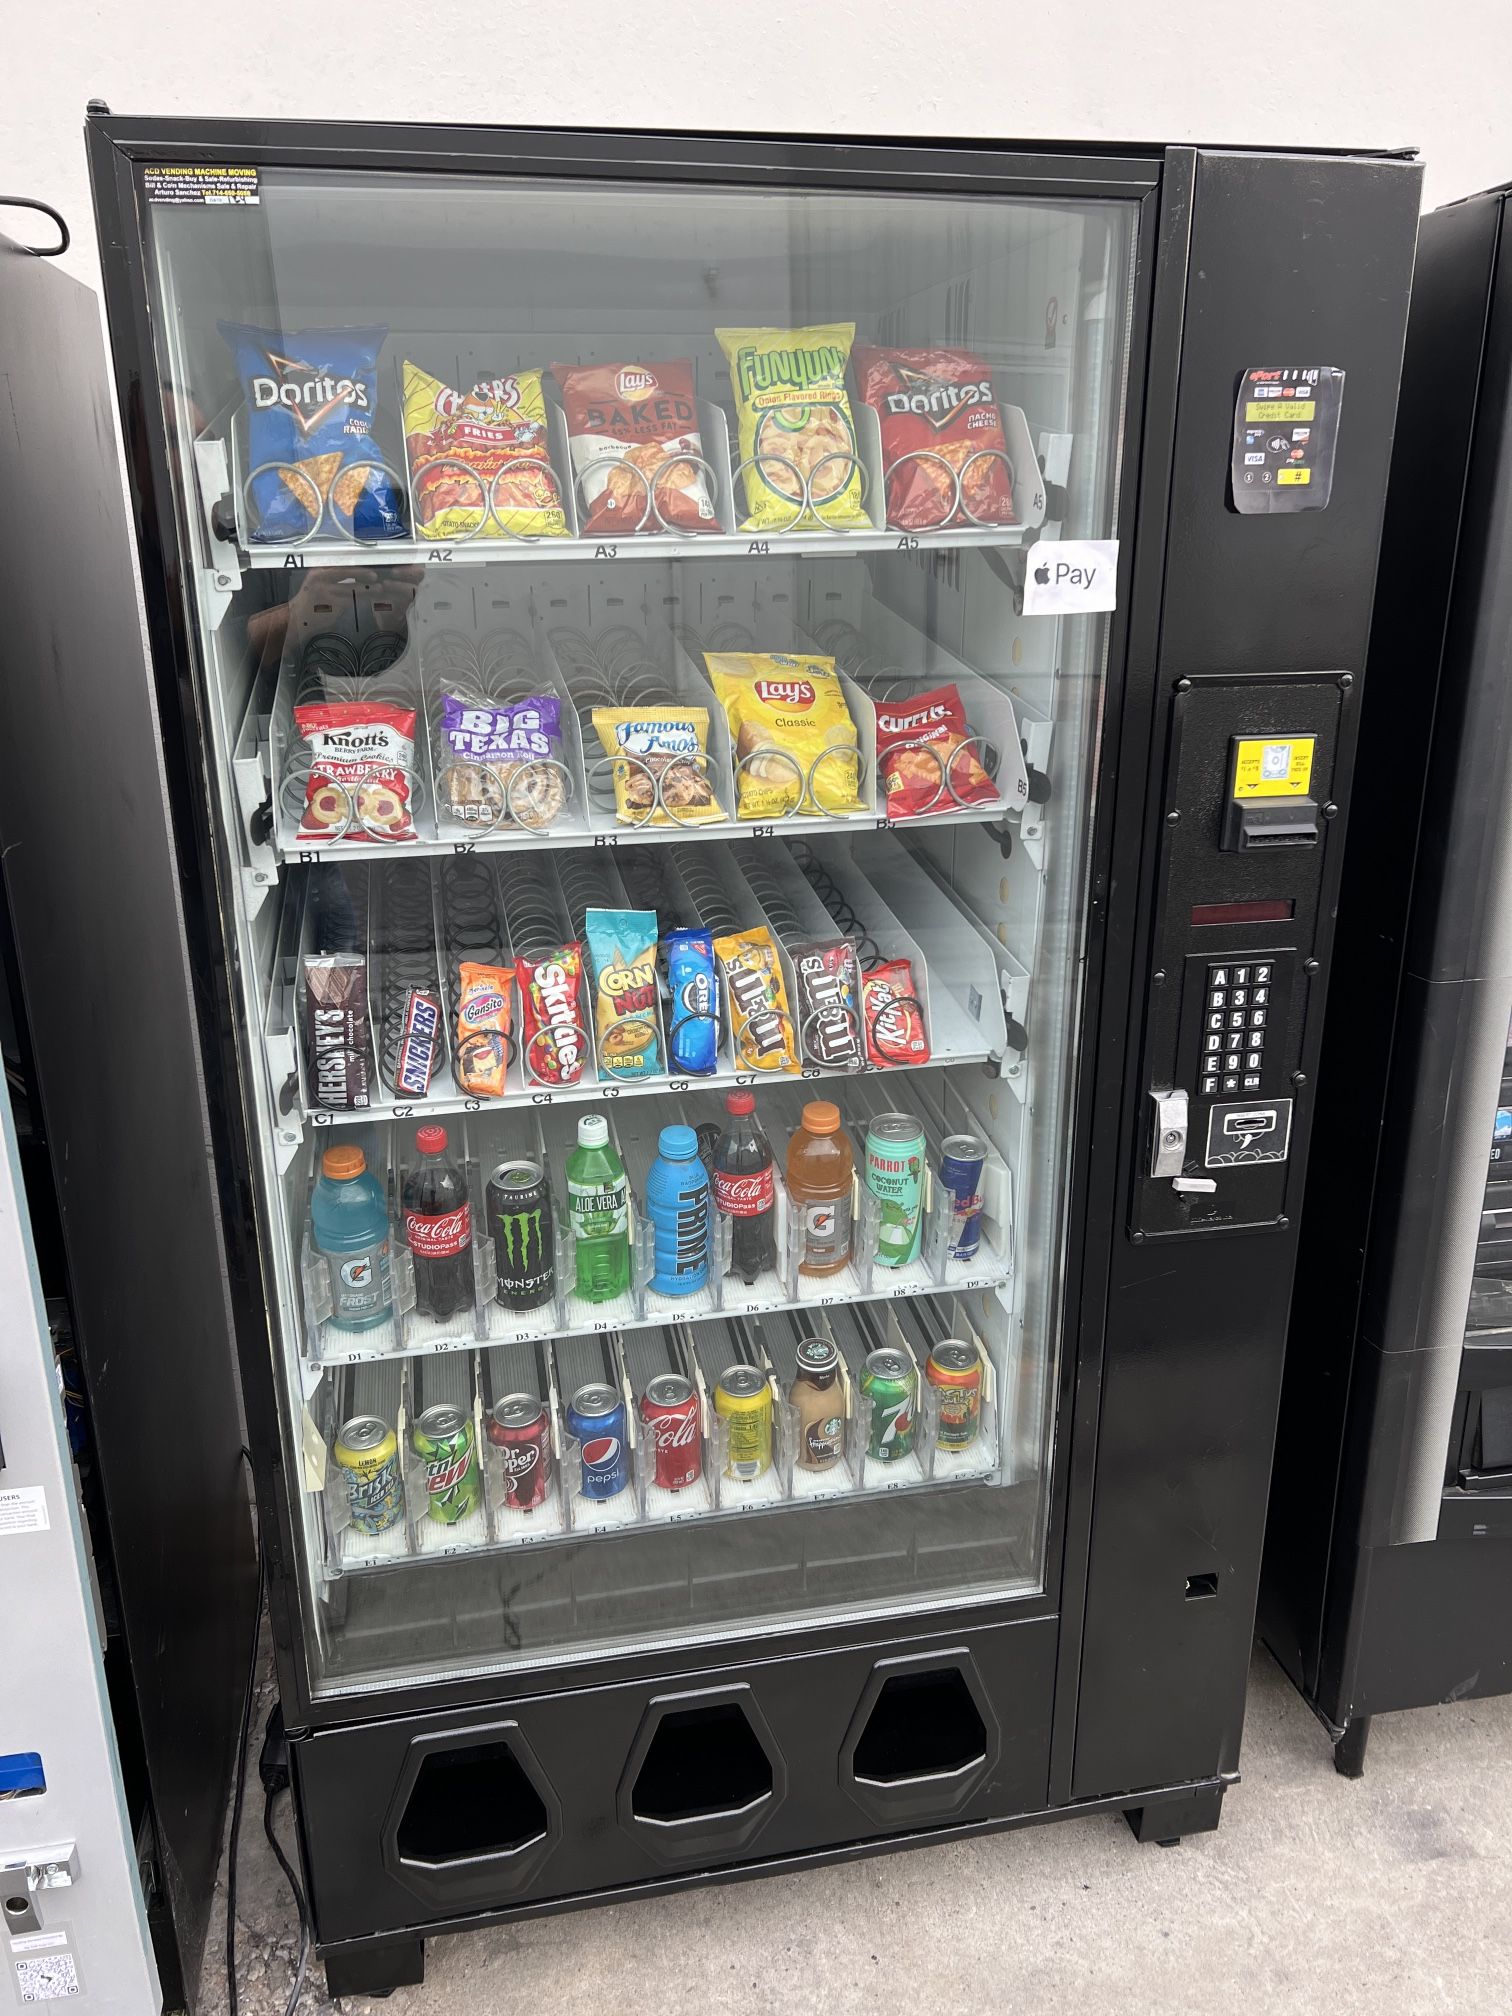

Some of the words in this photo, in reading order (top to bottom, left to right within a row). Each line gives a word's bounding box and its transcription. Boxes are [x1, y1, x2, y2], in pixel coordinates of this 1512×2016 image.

[144, 167, 160, 175] ACD
[161, 167, 193, 175] VENDING
[194, 168, 227, 176] MACHINE
[228, 168, 257, 177] MOVING
[236, 183, 257, 191] Repair
[253, 376, 368, 408] Doritos
[784, 390, 817, 403] Flavored
[887, 381, 993, 414] Doritos
[587, 399, 693, 428] BAKED
[463, 426, 504, 440] FRIES
[635, 424, 658, 434] LESS
[662, 422, 677, 431] FAT
[1032, 492, 1043, 511] A5
[748, 540, 770, 555] A4
[897, 536, 919, 550] A5
[428, 548, 453, 562] A2
[595, 544, 618, 559] A3
[284, 553, 305, 569] A1
[1055, 562, 1097, 590] Pay
[761, 680, 812, 704] Lay's
[460, 709, 541, 735] BIG
[775, 717, 817, 728] Classic
[323, 730, 389, 748] Knott's
[616, 721, 696, 747] Famous
[449, 729, 550, 754] TEXAS
[639, 735, 699, 755] Amos
[315, 751, 358, 763] Premium
[361, 752, 394, 763] Cookies
[462, 750, 514, 761] Cinnamon
[1017, 778, 1027, 796] B5
[876, 818, 896, 830] B5
[752, 826, 775, 838] B4
[454, 842, 476, 855] B2
[594, 835, 618, 848] B3
[300, 850, 320, 864] B1
[599, 964, 655, 997] CORN
[1214, 970, 1226, 985] A
[1237, 968, 1246, 983] 1
[1257, 967, 1268, 982] 2
[613, 985, 656, 1017] NUT
[1213, 992, 1224, 1007] B
[1234, 990, 1245, 1005] 3
[1255, 989, 1265, 1003] 4
[467, 998, 503, 1021] Gansito
[534, 964, 578, 1081] Skittles
[1211, 1014, 1222, 1029] C
[1232, 1012, 1242, 1027] 5
[1253, 1011, 1263, 1026] 6
[346, 1010, 354, 1045] chocolate
[403, 1000, 437, 1093] SNICKERS
[1208, 1035, 1219, 1050] D
[1231, 1034, 1240, 1048] 7
[1251, 1032, 1261, 1047] 8
[1207, 1057, 1217, 1071] E
[1228, 1055, 1238, 1070] 9
[1249, 1053, 1259, 1068] 0
[736, 1073, 757, 1086] C7
[801, 1068, 820, 1079] C8
[669, 1080, 689, 1091] C6
[1206, 1078, 1215, 1092] F
[1244, 1077, 1260, 1087] CLR
[532, 1093, 553, 1104] C4
[602, 1087, 620, 1098] C5
[392, 1106, 414, 1118] C2
[464, 1100, 481, 1111] C3
[315, 1113, 334, 1125] C1
[869, 1153, 906, 1173] PARROT
[713, 1172, 765, 1198] Coca-Cola
[871, 1172, 909, 1186] COCONUT
[876, 1183, 903, 1194] WATER
[575, 1196, 596, 1212] ALOE
[596, 1194, 619, 1211] VERA
[406, 1212, 464, 1239] Coca-Cola
[806, 1205, 835, 1237] G
[676, 1181, 709, 1276] PRIME
[496, 1267, 554, 1289] MONSTER
[966, 1280, 979, 1289] D9
[893, 1288, 906, 1297] D8
[746, 1304, 760, 1313] D6
[821, 1297, 834, 1306] D7
[672, 1313, 686, 1322] D5
[594, 1323, 607, 1331] D4
[515, 1332, 530, 1342] D3
[434, 1342, 449, 1352] D2
[348, 1352, 362, 1362] D1
[358, 1458, 377, 1467] LEMON
[587, 1470, 620, 1484] pepsi
[887, 1482, 899, 1490] E8
[742, 1503, 754, 1511] E6
[594, 1526, 607, 1534] E4
[444, 1547, 457, 1555] E2
[365, 1559, 377, 1567] E1
